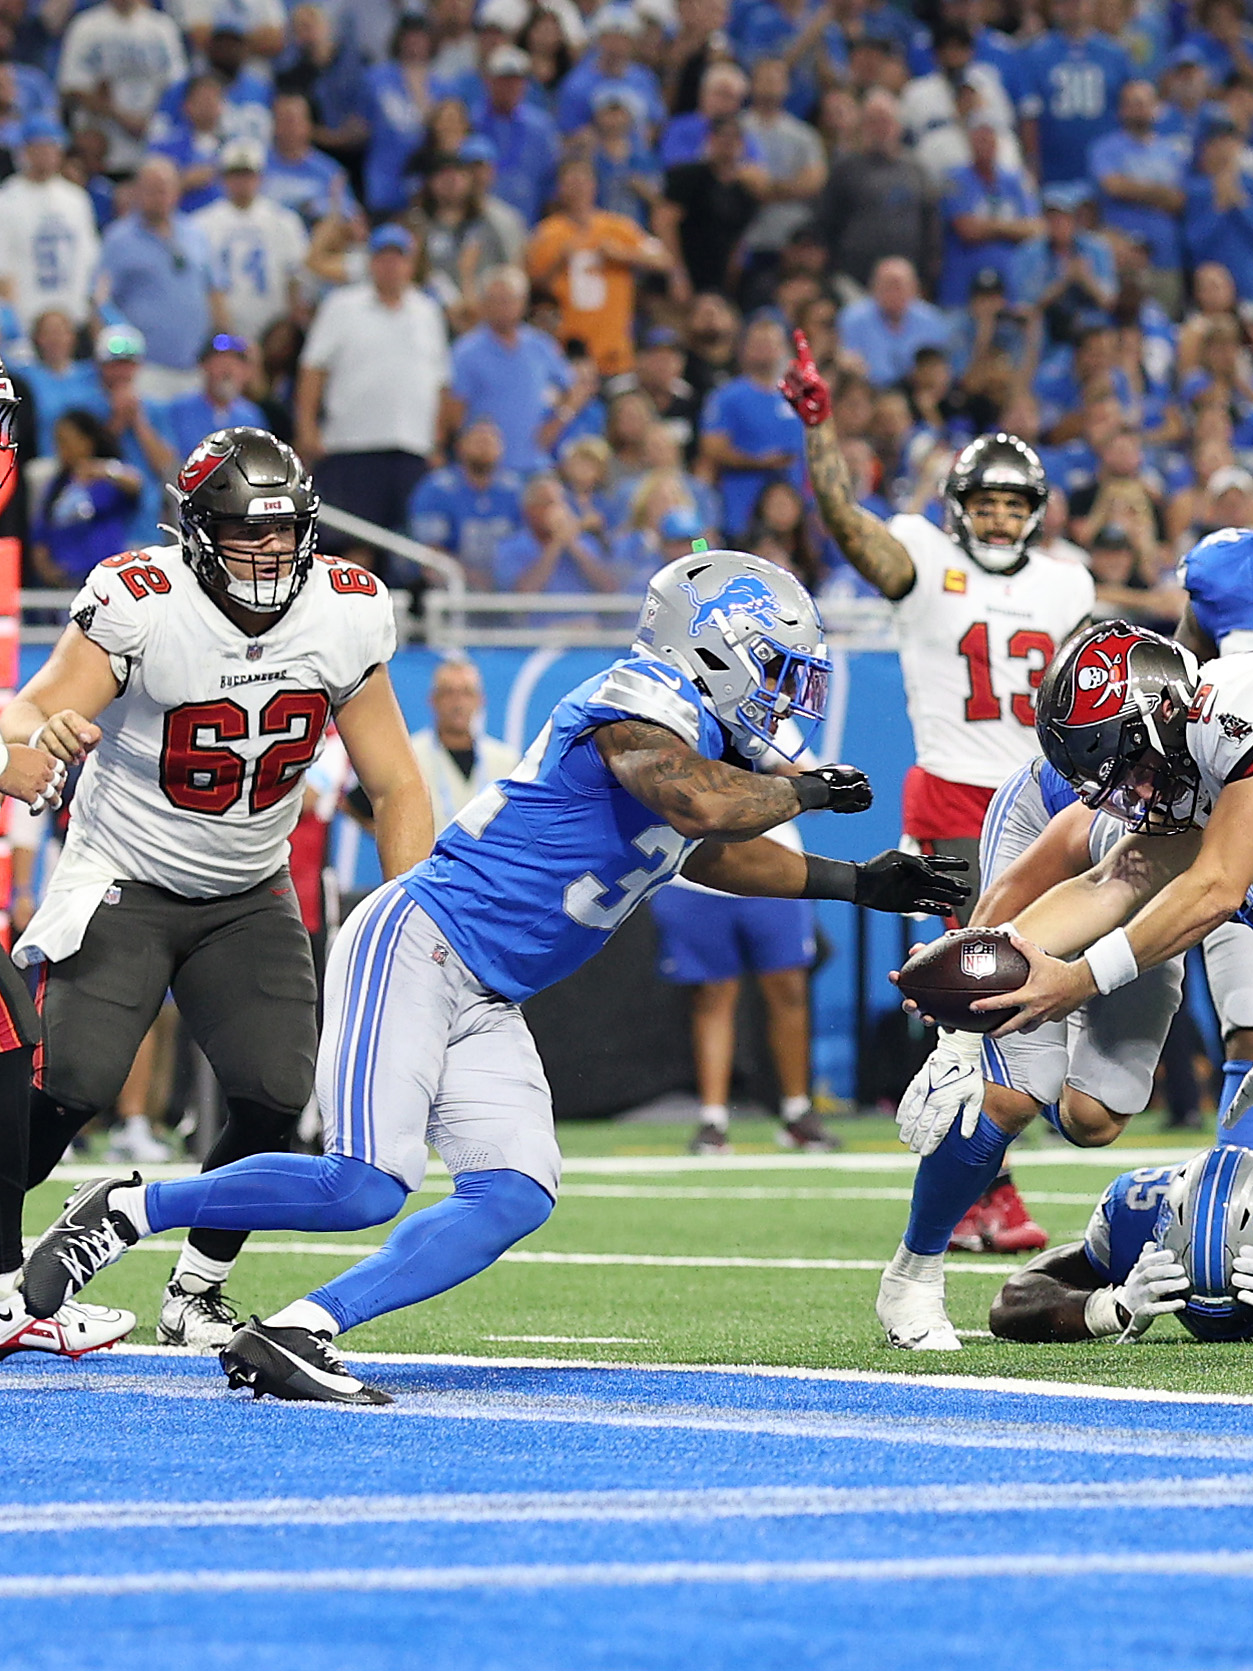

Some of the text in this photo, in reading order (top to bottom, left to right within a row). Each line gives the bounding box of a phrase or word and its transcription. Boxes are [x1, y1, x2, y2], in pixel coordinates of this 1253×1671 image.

[219, 669, 288, 689] BUCCANEERS
[958, 621, 1055, 727] 13
[159, 688, 332, 817] 62
[965, 954, 990, 973] NFL
